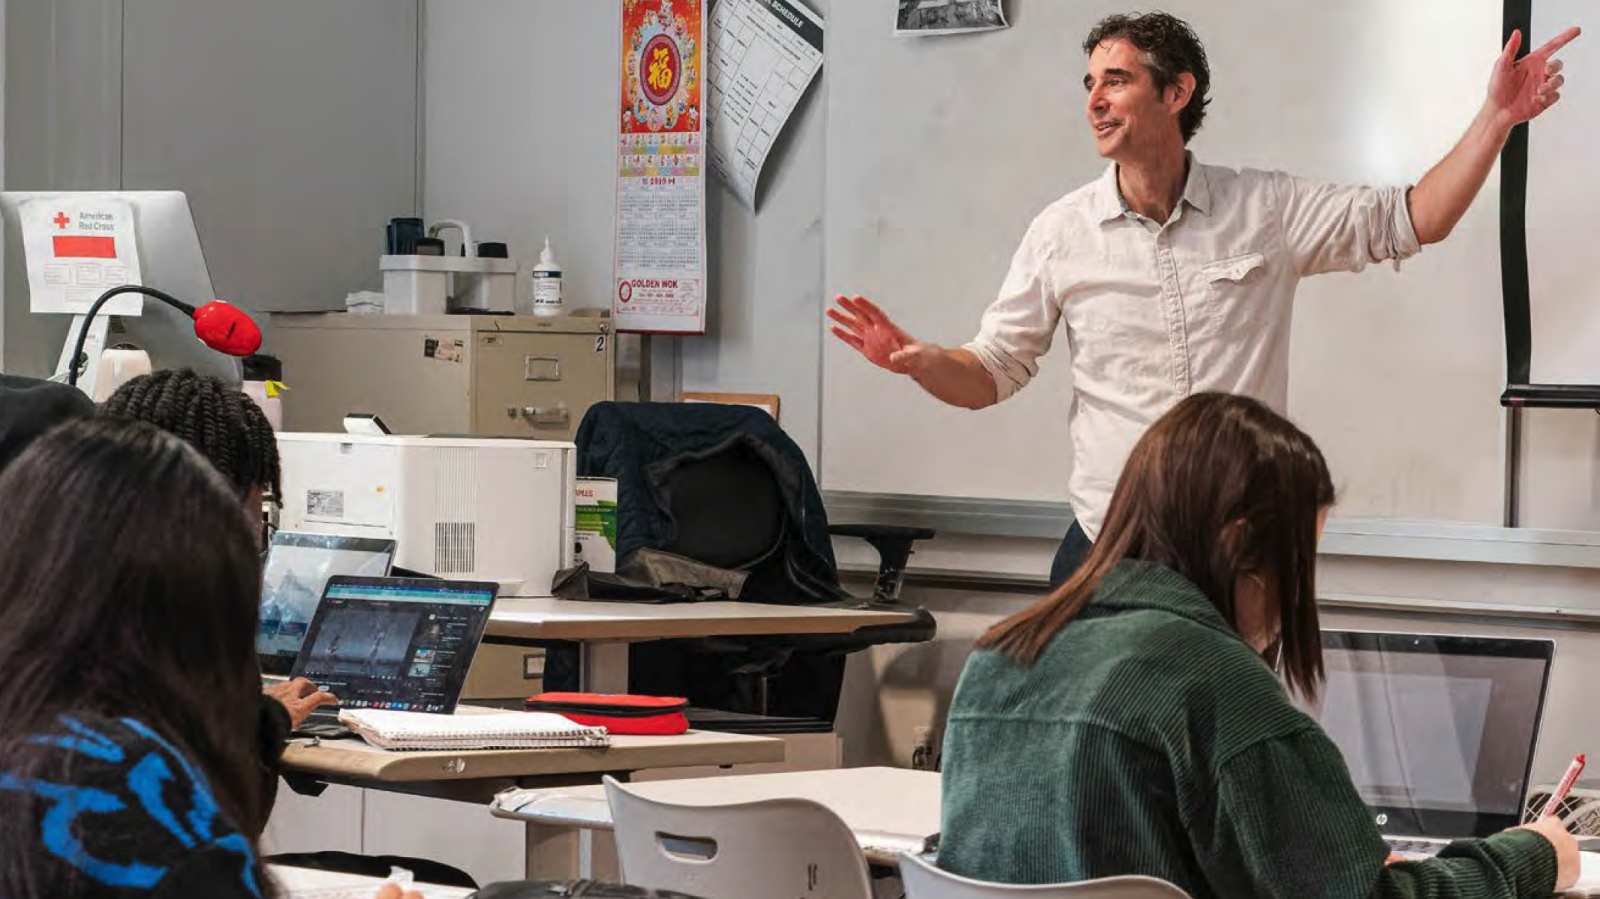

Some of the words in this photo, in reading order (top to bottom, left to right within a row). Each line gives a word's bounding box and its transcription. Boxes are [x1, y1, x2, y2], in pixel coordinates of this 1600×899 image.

[771, 0, 804, 28] SCHEDULE
[648, 48, 673, 90] 福
[79, 211, 113, 221] American
[79, 222, 93, 230] Red
[94, 222, 115, 231] Cross
[631, 279, 660, 288] GOLDEN
[661, 280, 678, 289] WOK
[596, 336, 605, 352] 2
